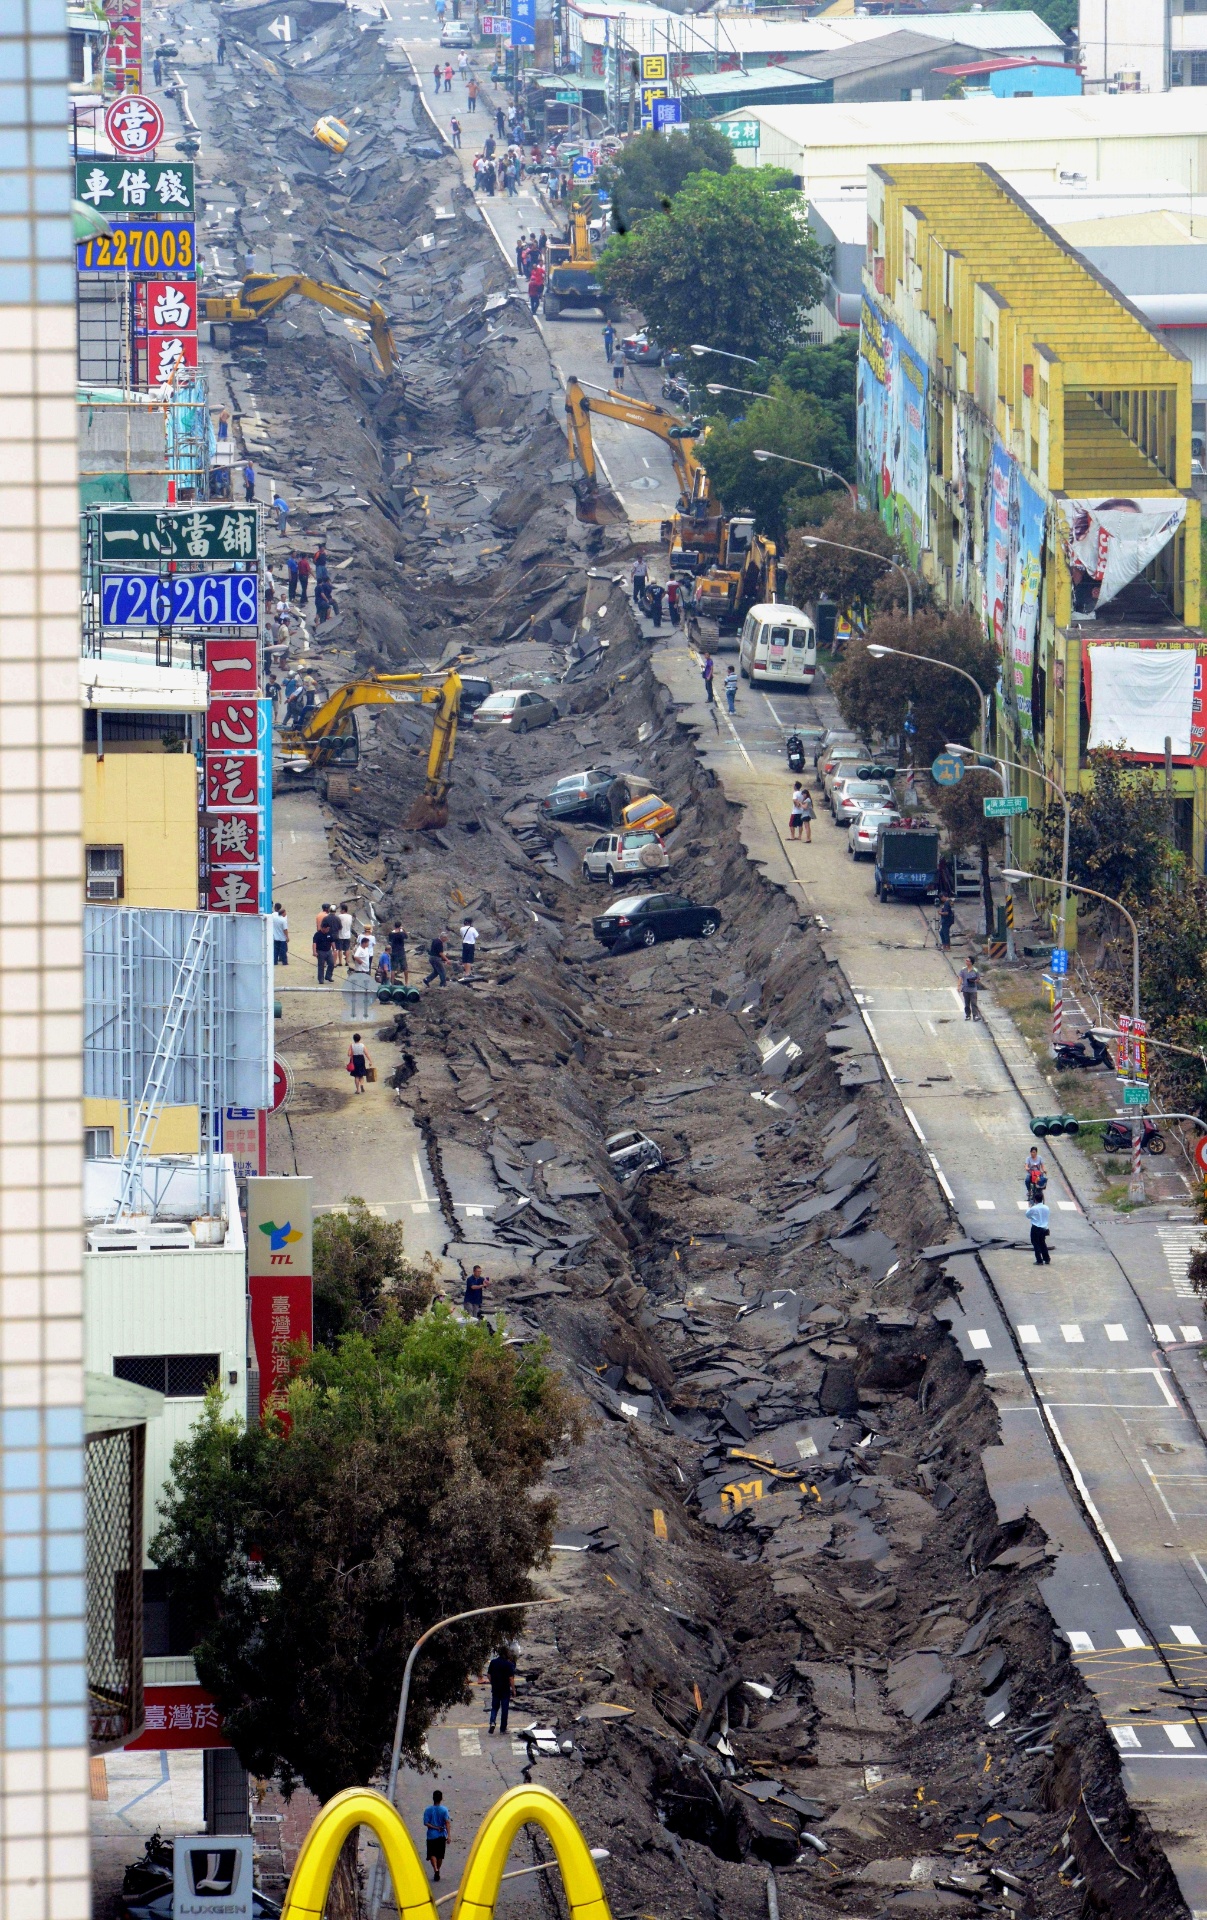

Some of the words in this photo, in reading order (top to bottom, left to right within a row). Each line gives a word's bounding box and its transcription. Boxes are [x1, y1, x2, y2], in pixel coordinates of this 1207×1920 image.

[113, 104, 154, 147] 當
[81, 167, 190, 208] 車借錢
[85, 229, 192, 267] 7227003
[103, 511, 255, 558] 一心當舖
[103, 576, 256, 626] 7262618
[210, 656, 257, 912] 一心汽機車
[270, 1254, 294, 1265] TTL
[144, 1702, 227, 1730] 臺灣菸
[180, 1904, 247, 1915] LUXGEN
